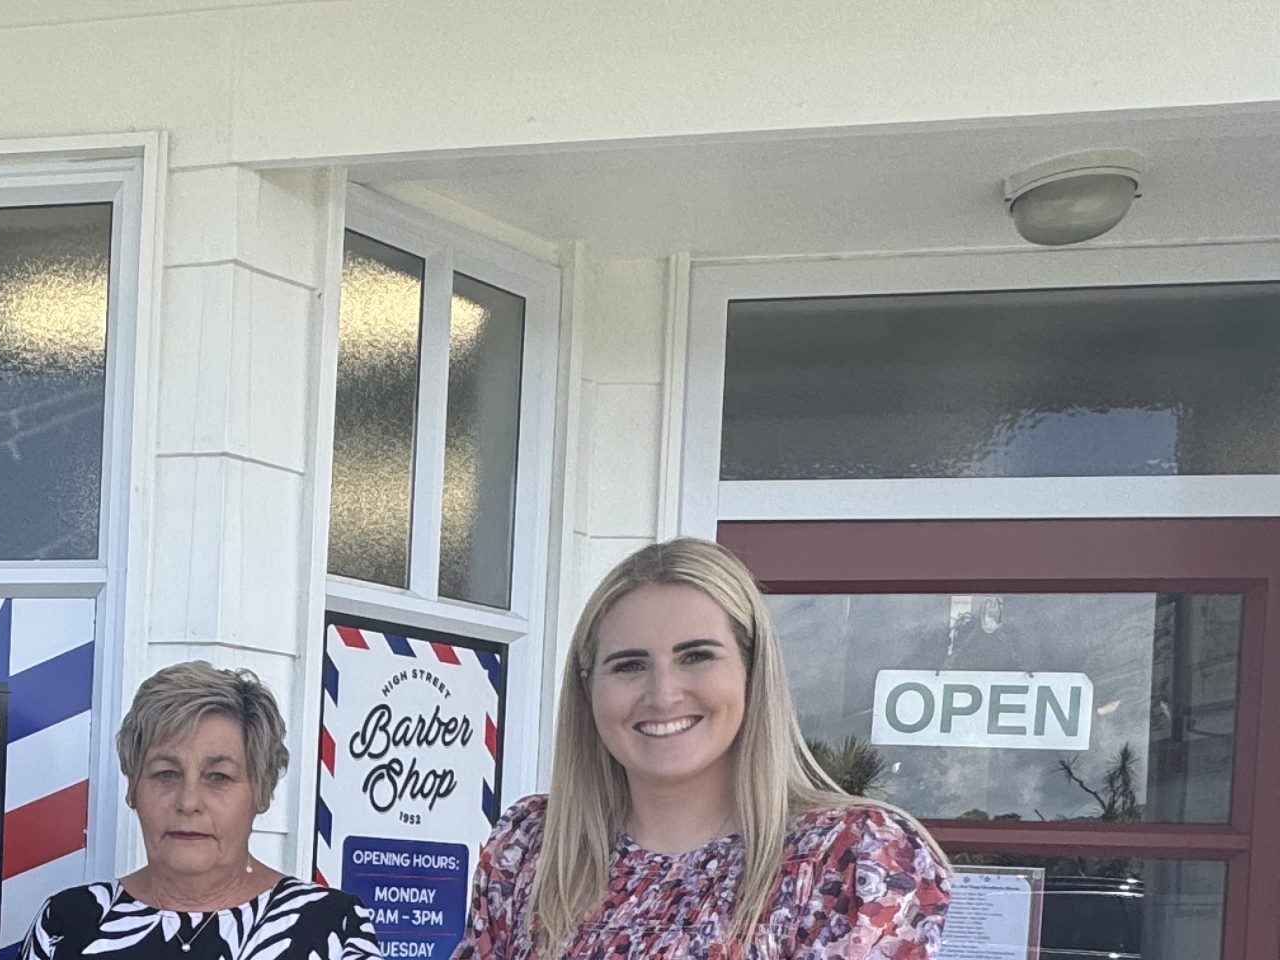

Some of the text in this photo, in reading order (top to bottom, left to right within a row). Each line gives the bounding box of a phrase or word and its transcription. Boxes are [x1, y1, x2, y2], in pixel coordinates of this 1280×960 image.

[381, 668, 451, 699] HIGH STREET
[885, 682, 1082, 737] OPEN
[349, 704, 473, 759] Barber
[362, 757, 457, 812] Shop
[399, 811, 421, 825] 1952
[352, 850, 460, 870] OPENING HOURS:
[374, 886, 436, 904] MONDAY
[411, 910, 444, 926] 3PM
